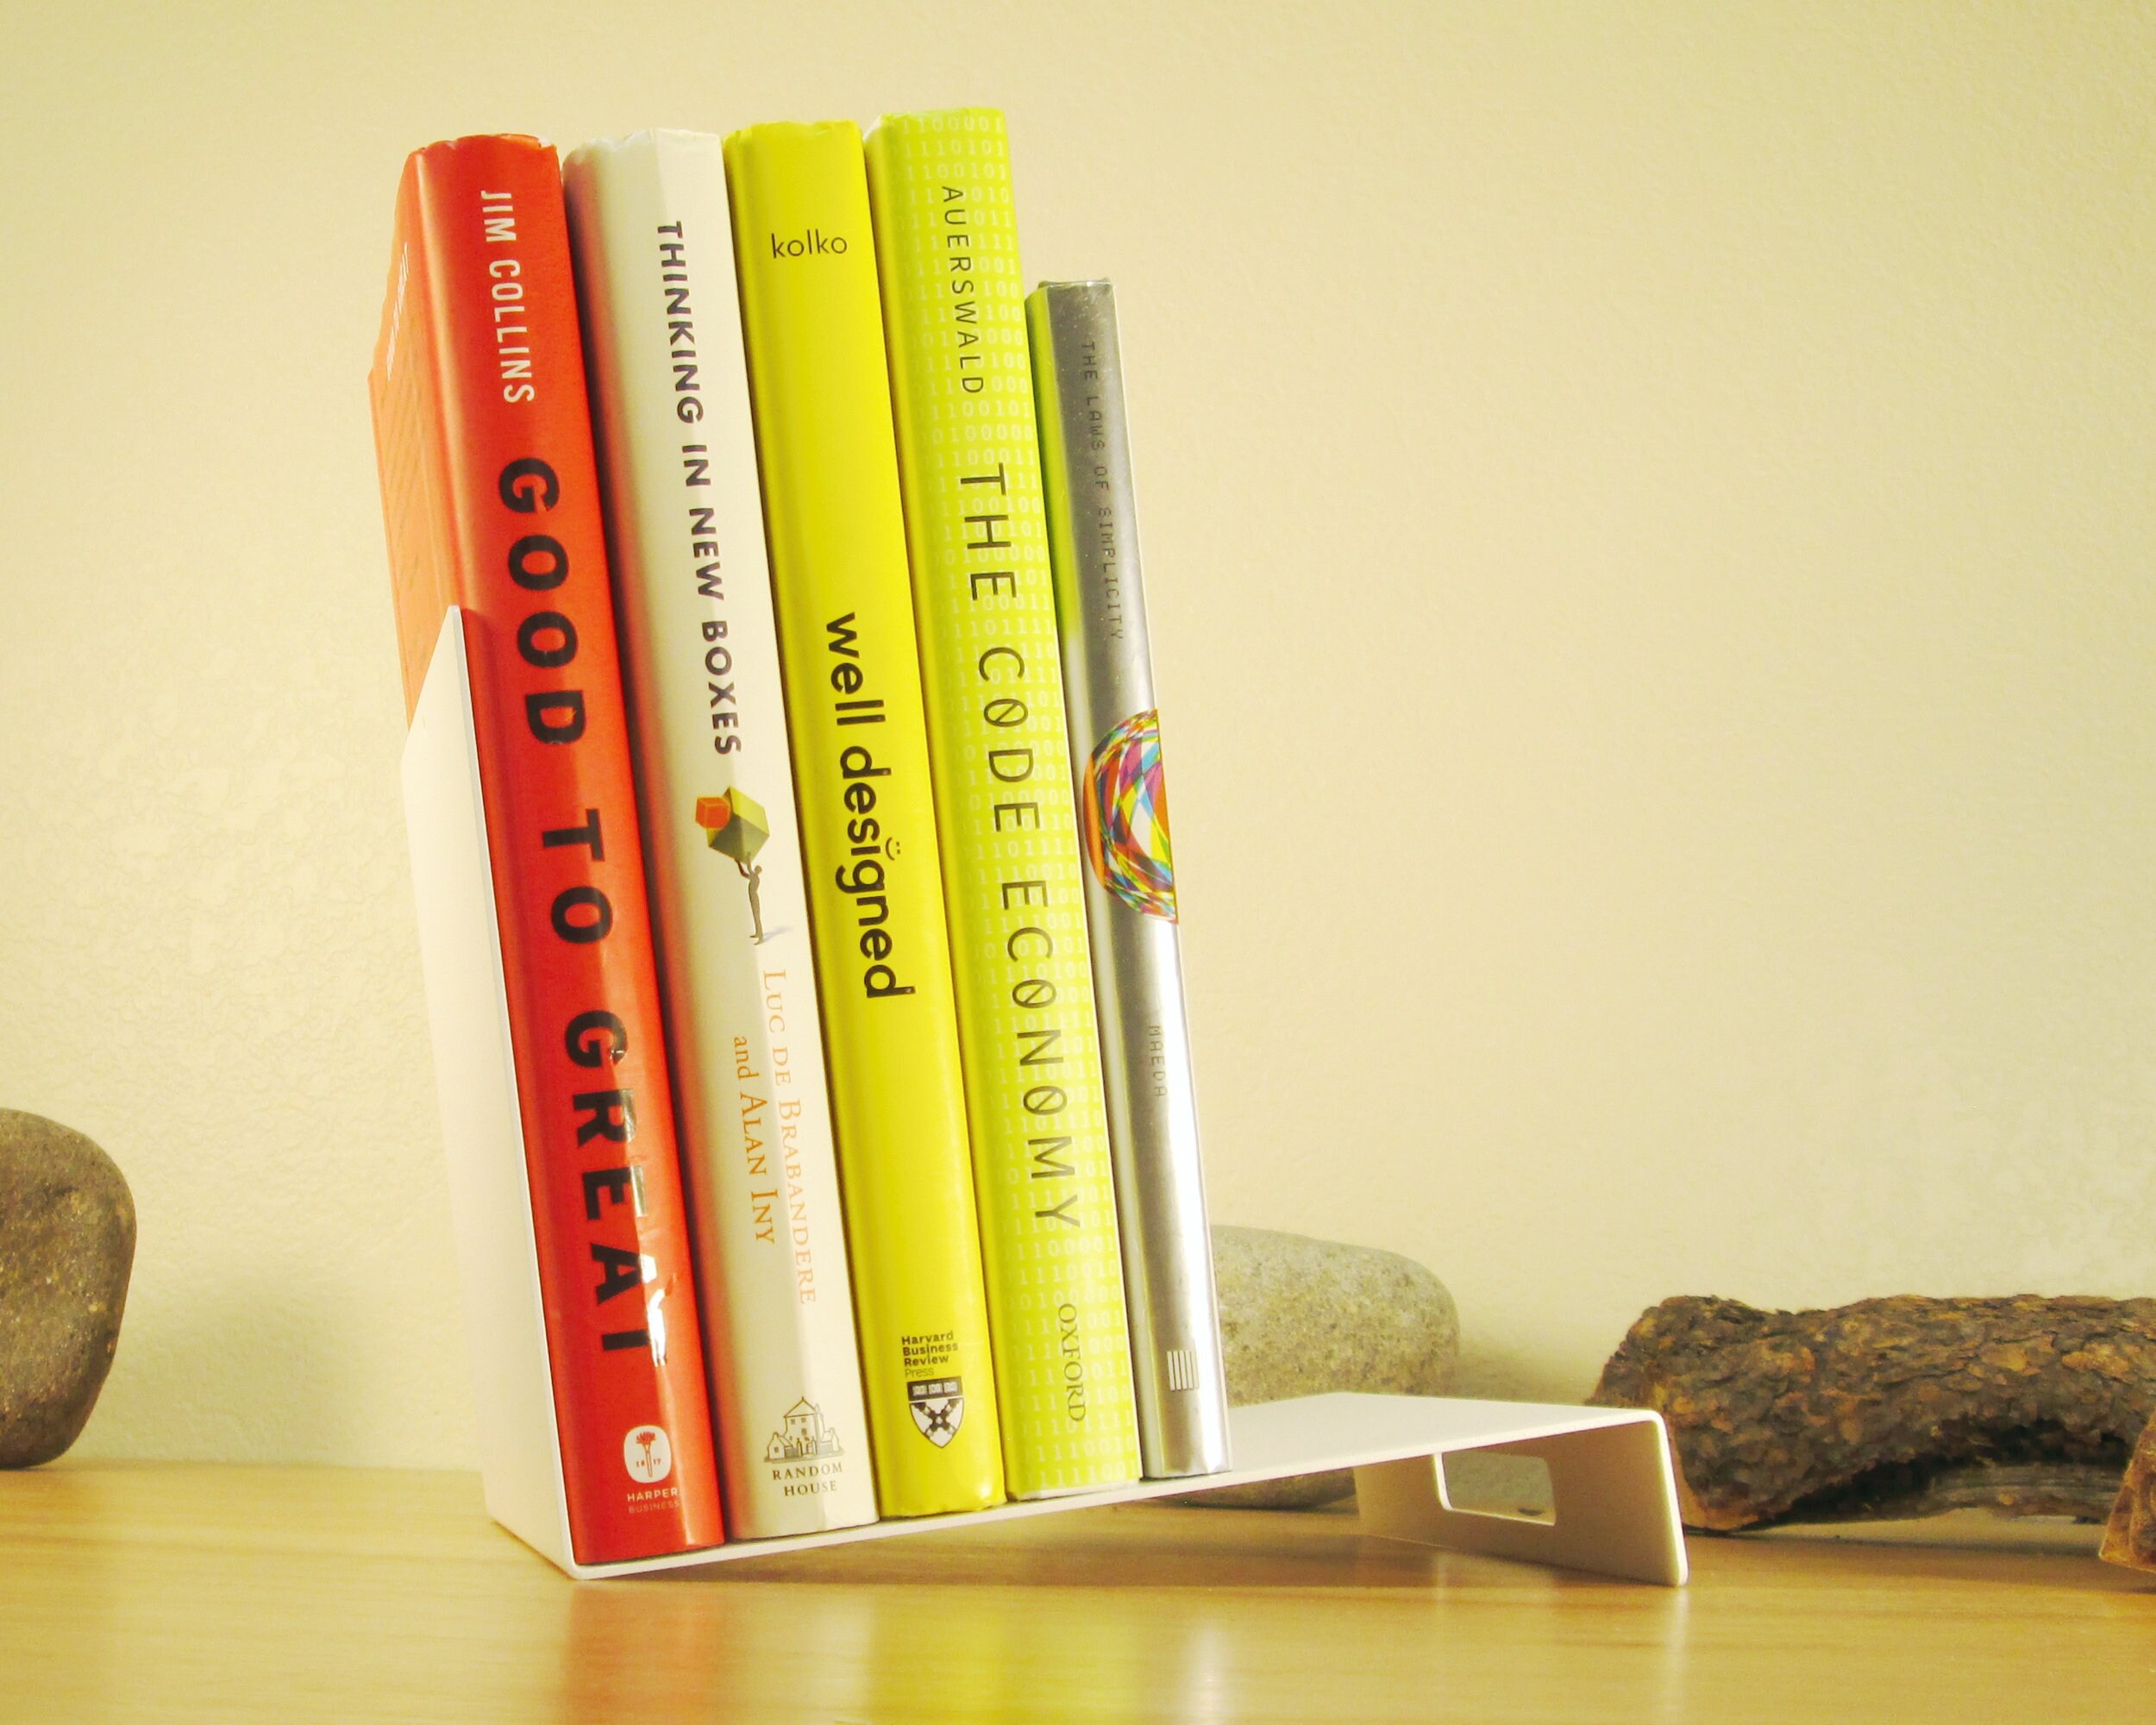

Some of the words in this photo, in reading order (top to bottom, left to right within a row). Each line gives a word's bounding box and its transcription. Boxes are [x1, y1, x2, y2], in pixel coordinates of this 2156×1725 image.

[480, 191, 517, 242] JIM
[772, 229, 848, 259] kolko
[942, 186, 984, 393] AUERSWALD
[489, 260, 534, 403] COLLINS
[657, 221, 704, 423] THINKING
[1082, 342, 1099, 380] THE
[1087, 397, 1106, 450] LAWS
[681, 444, 711, 486] IN
[1094, 466, 1109, 491] OF
[688, 507, 724, 600] NEW
[960, 463, 1016, 601] THE
[1098, 507, 1124, 640] SIMPLICITY
[701, 621, 741, 755] BOXES
[826, 612, 886, 725] well
[498, 458, 586, 743] GOOD
[542, 808, 613, 944] TO
[836, 746, 916, 999] designed
[733, 1036, 759, 1080] and
[1148, 1026, 1167, 1098] MAEDA
[739, 1092, 768, 1175] ALAN
[752, 1189, 778, 1246] INY
[901, 1331, 954, 1346] Harvard
[902, 1343, 959, 1357] Business
[904, 1354, 949, 1367] Review
[1058, 1303, 1087, 1421] OXFORD
[905, 1368, 935, 1377] Press
[627, 1487, 678, 1502] HARPER
[772, 1463, 843, 1481] RANDOM
[783, 1481, 837, 1497] HOUSE
[629, 1500, 680, 1514] BUSINESS
